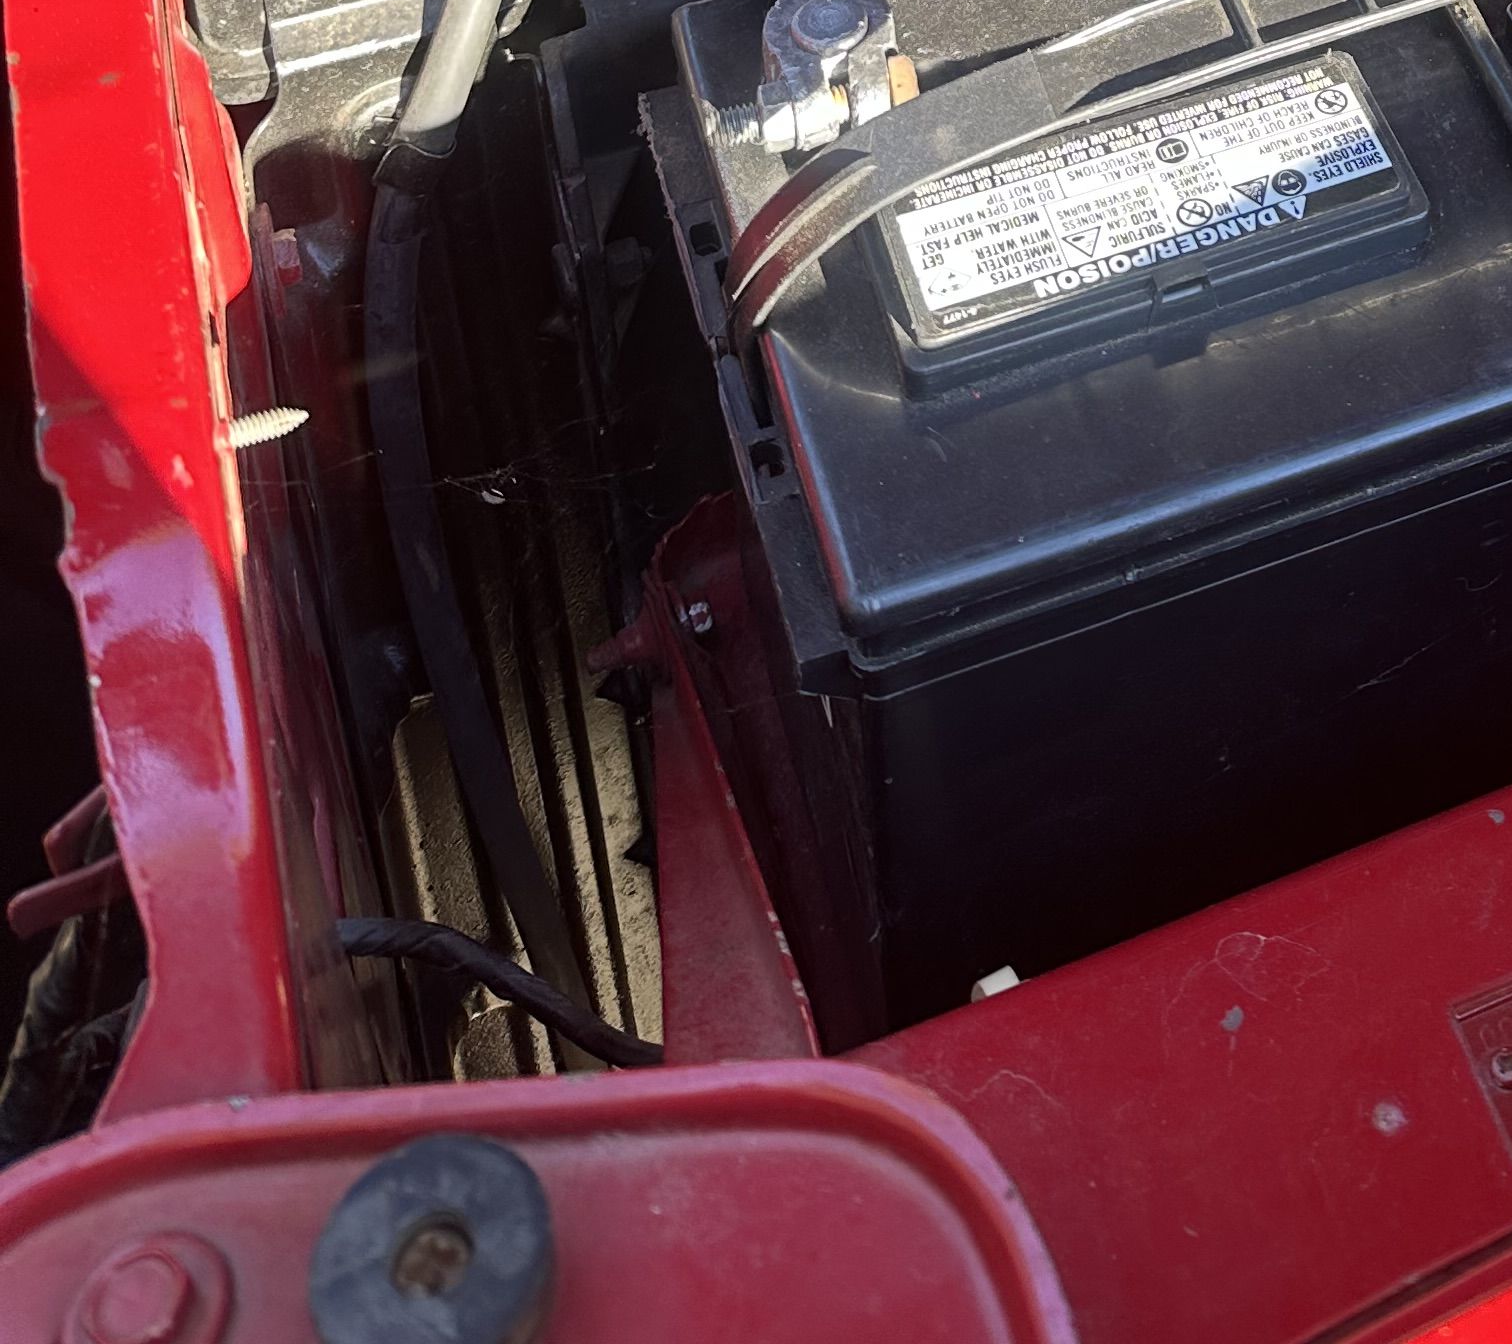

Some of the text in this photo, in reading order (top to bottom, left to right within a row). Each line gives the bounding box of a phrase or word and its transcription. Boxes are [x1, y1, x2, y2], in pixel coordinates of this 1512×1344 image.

[1197, 100, 1310, 141] REACH OF CHILDREN
[1220, 110, 1315, 146] KEEP OUT OF THE
[1256, 115, 1362, 155] BLINDNESS OR INJURY
[1276, 126, 1370, 163] GASES CAN CAUSE
[1313, 138, 1377, 167] EXPLOSIVE
[1065, 147, 1151, 181] INSTRUCTIONS
[1100, 158, 1155, 183] READ ALL
[1342, 151, 1384, 173] SHIELD
[984, 177, 1050, 205] DO NOT TIP
[1055, 185, 1148, 220] OR SEVERE BURNS
[921, 188, 1055, 237] DO NOT OPEN BATTERY
[985, 209, 1040, 236] MEDICAL
[1061, 196, 1153, 232] CAUSE BLINDNESS
[1105, 207, 1159, 231] ACID CAN
[1213, 200, 1232, 216] NO
[951, 226, 984, 246] HELP
[1019, 227, 1051, 246] WITH
[1107, 221, 1166, 248] SULFURIC
[919, 252, 944, 270] GET
[974, 240, 1056, 275] IMMEDIATELY
[1032, 206, 1280, 298] DANGER/POISON
[989, 253, 1062, 285] FLUSH EYES
